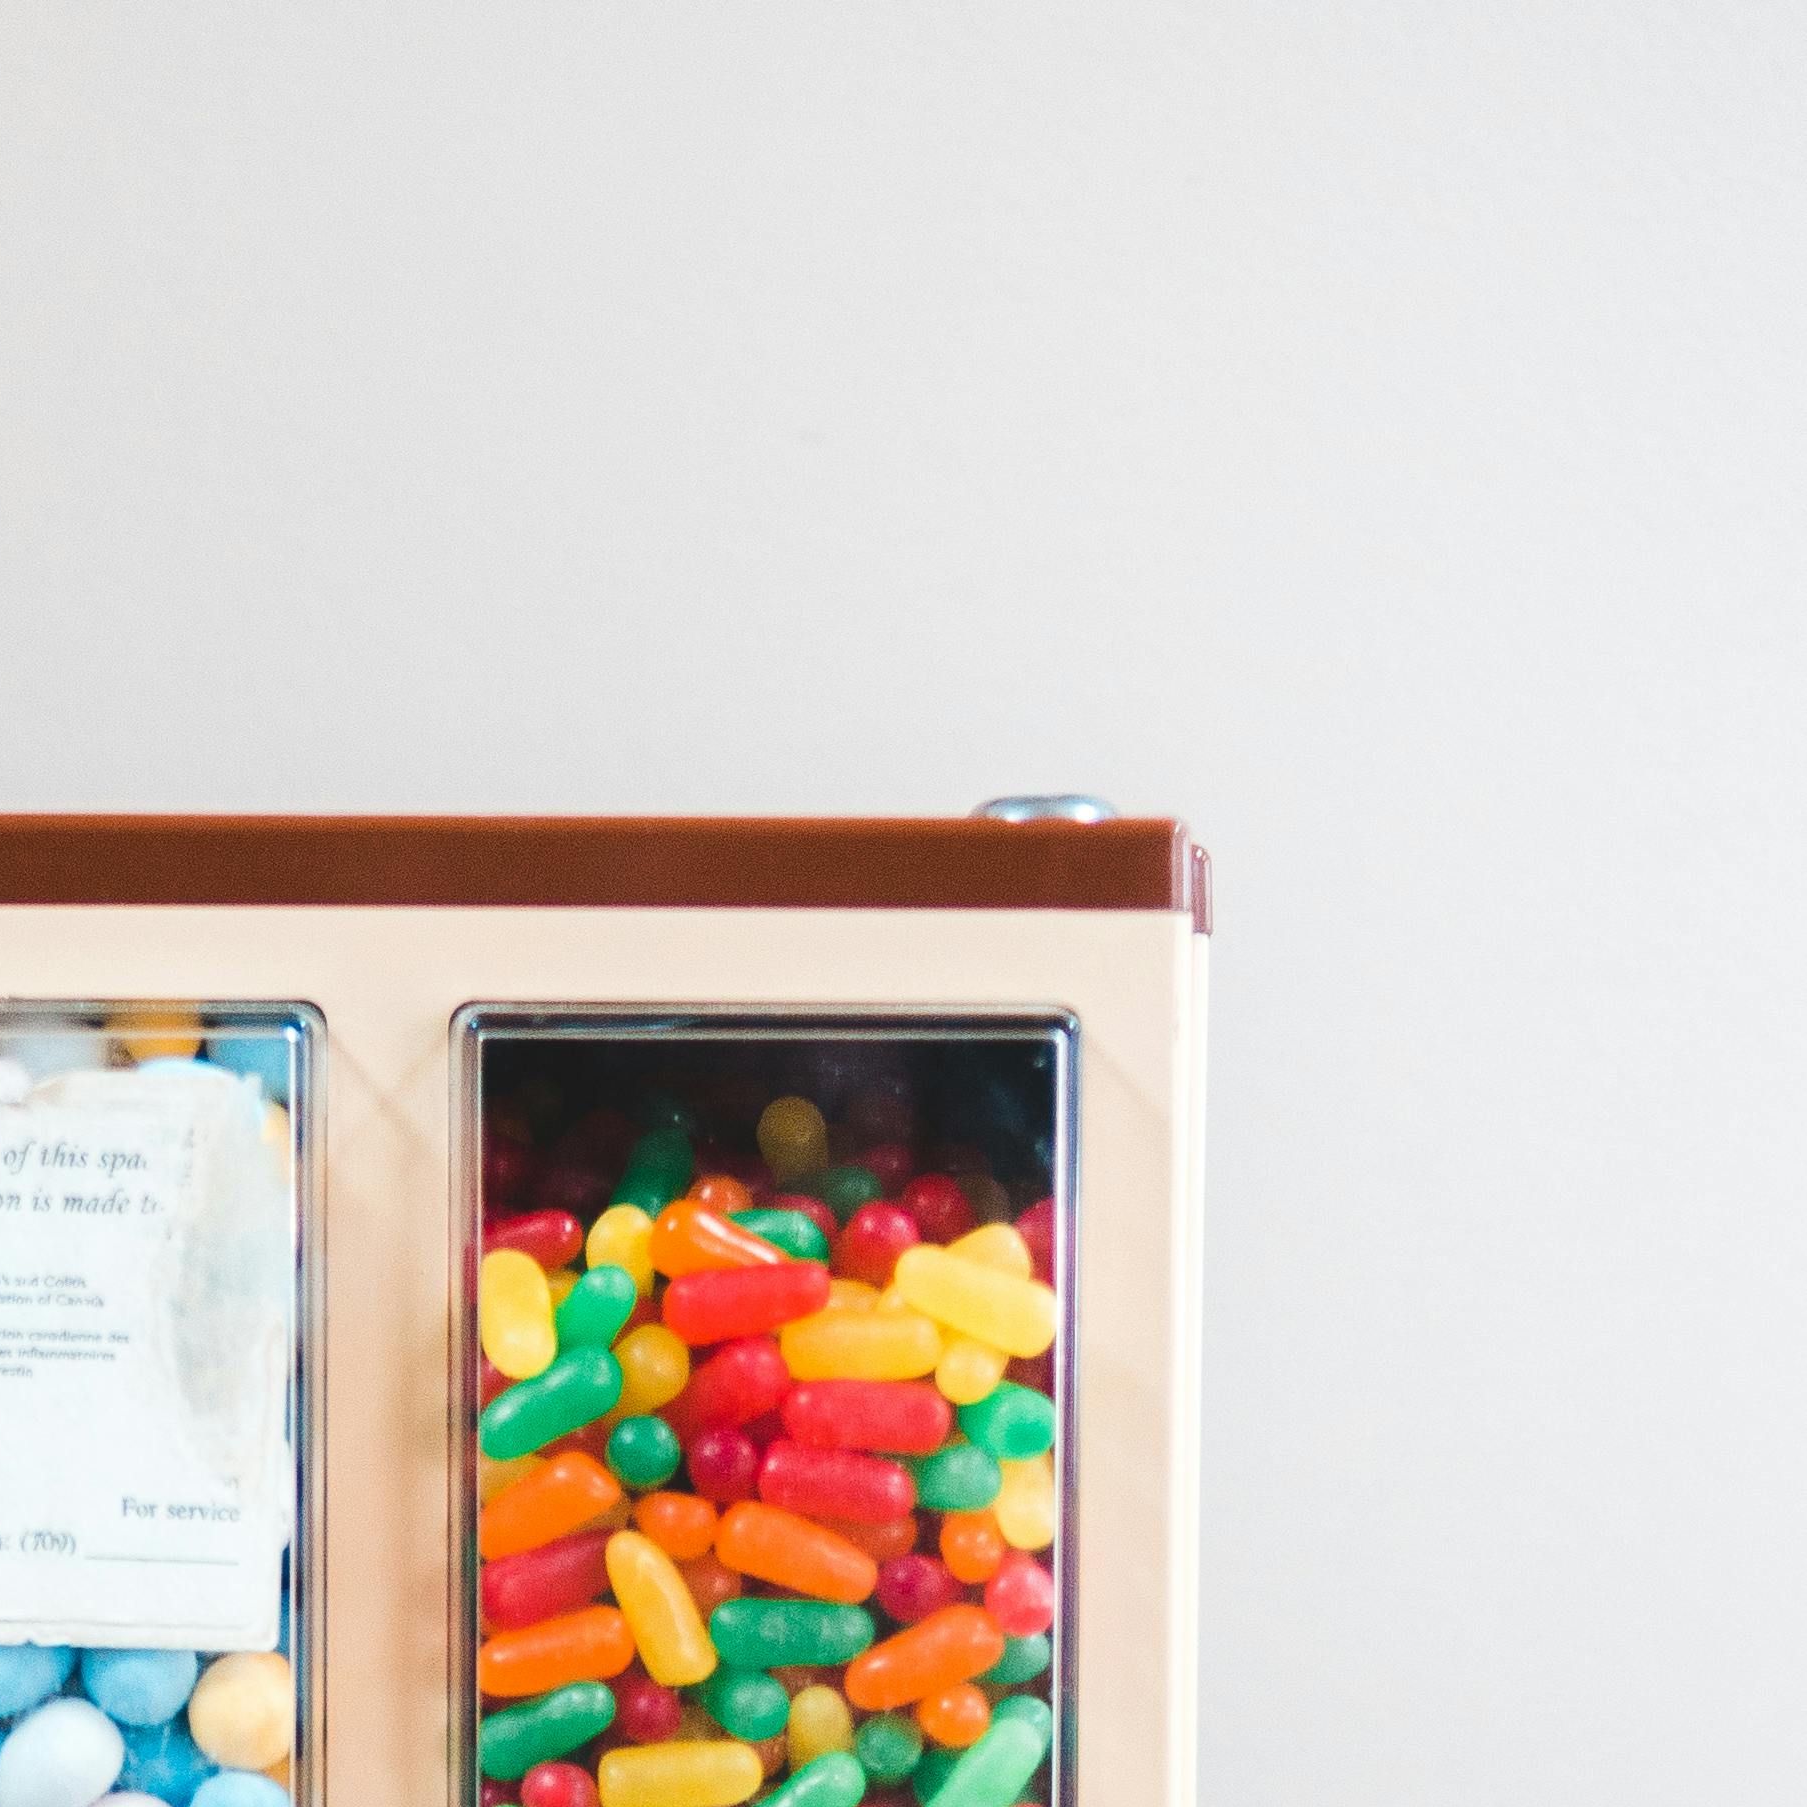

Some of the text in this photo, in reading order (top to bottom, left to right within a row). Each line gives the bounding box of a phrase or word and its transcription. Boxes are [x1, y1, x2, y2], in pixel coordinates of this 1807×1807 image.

[3, 1138, 37, 1174] of
[41, 1140, 89, 1168] this
[98, 1148, 147, 1178] spa
[31, 1187, 51, 1213] is
[63, 1187, 130, 1215] made
[15, 1273, 39, 1287] and
[37, 1291, 51, 1305] of
[121, 1495, 241, 1523] For service
